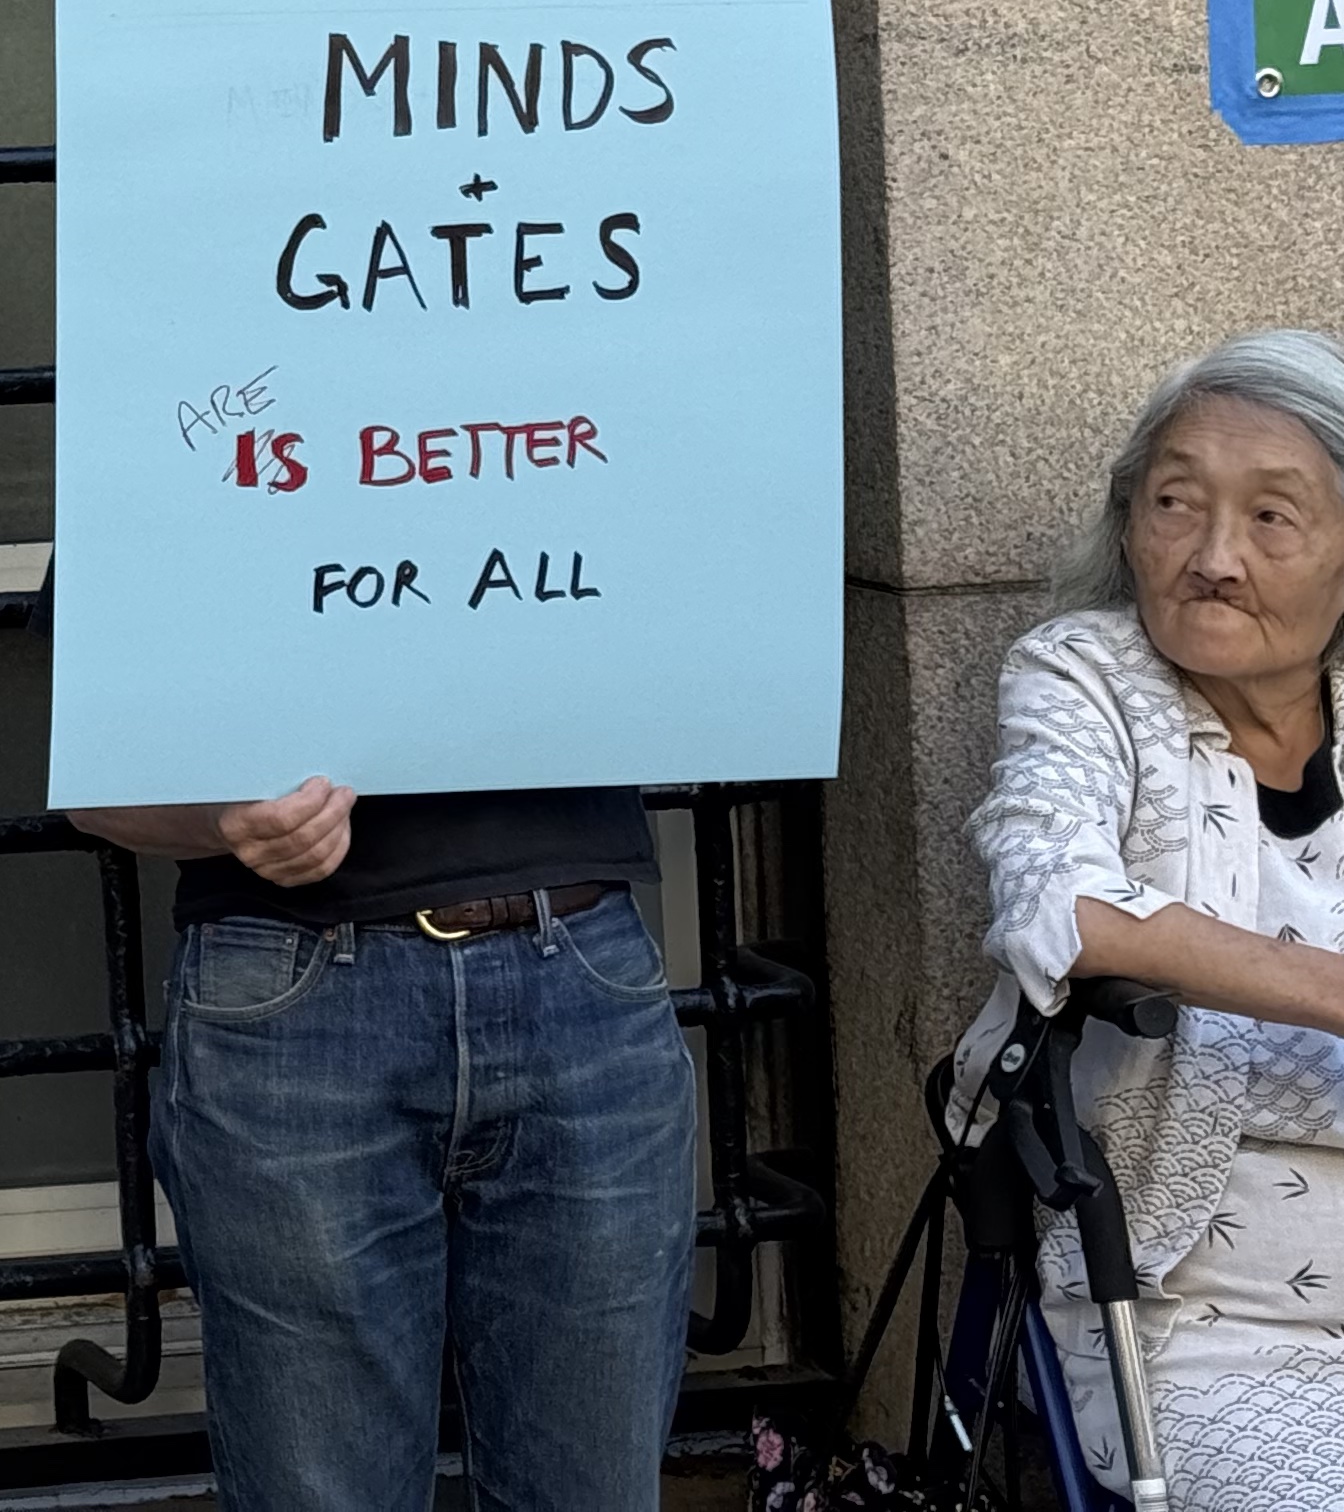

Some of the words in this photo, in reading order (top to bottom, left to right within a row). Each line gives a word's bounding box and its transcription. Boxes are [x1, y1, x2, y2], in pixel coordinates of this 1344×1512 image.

[322, 33, 678, 144] MINDS
[276, 211, 642, 313] GATES
[178, 365, 279, 452] ARE
[235, 428, 309, 493] IS
[358, 415, 610, 487] BETTER
[312, 559, 432, 615] FOR
[467, 547, 603, 611] ALL
